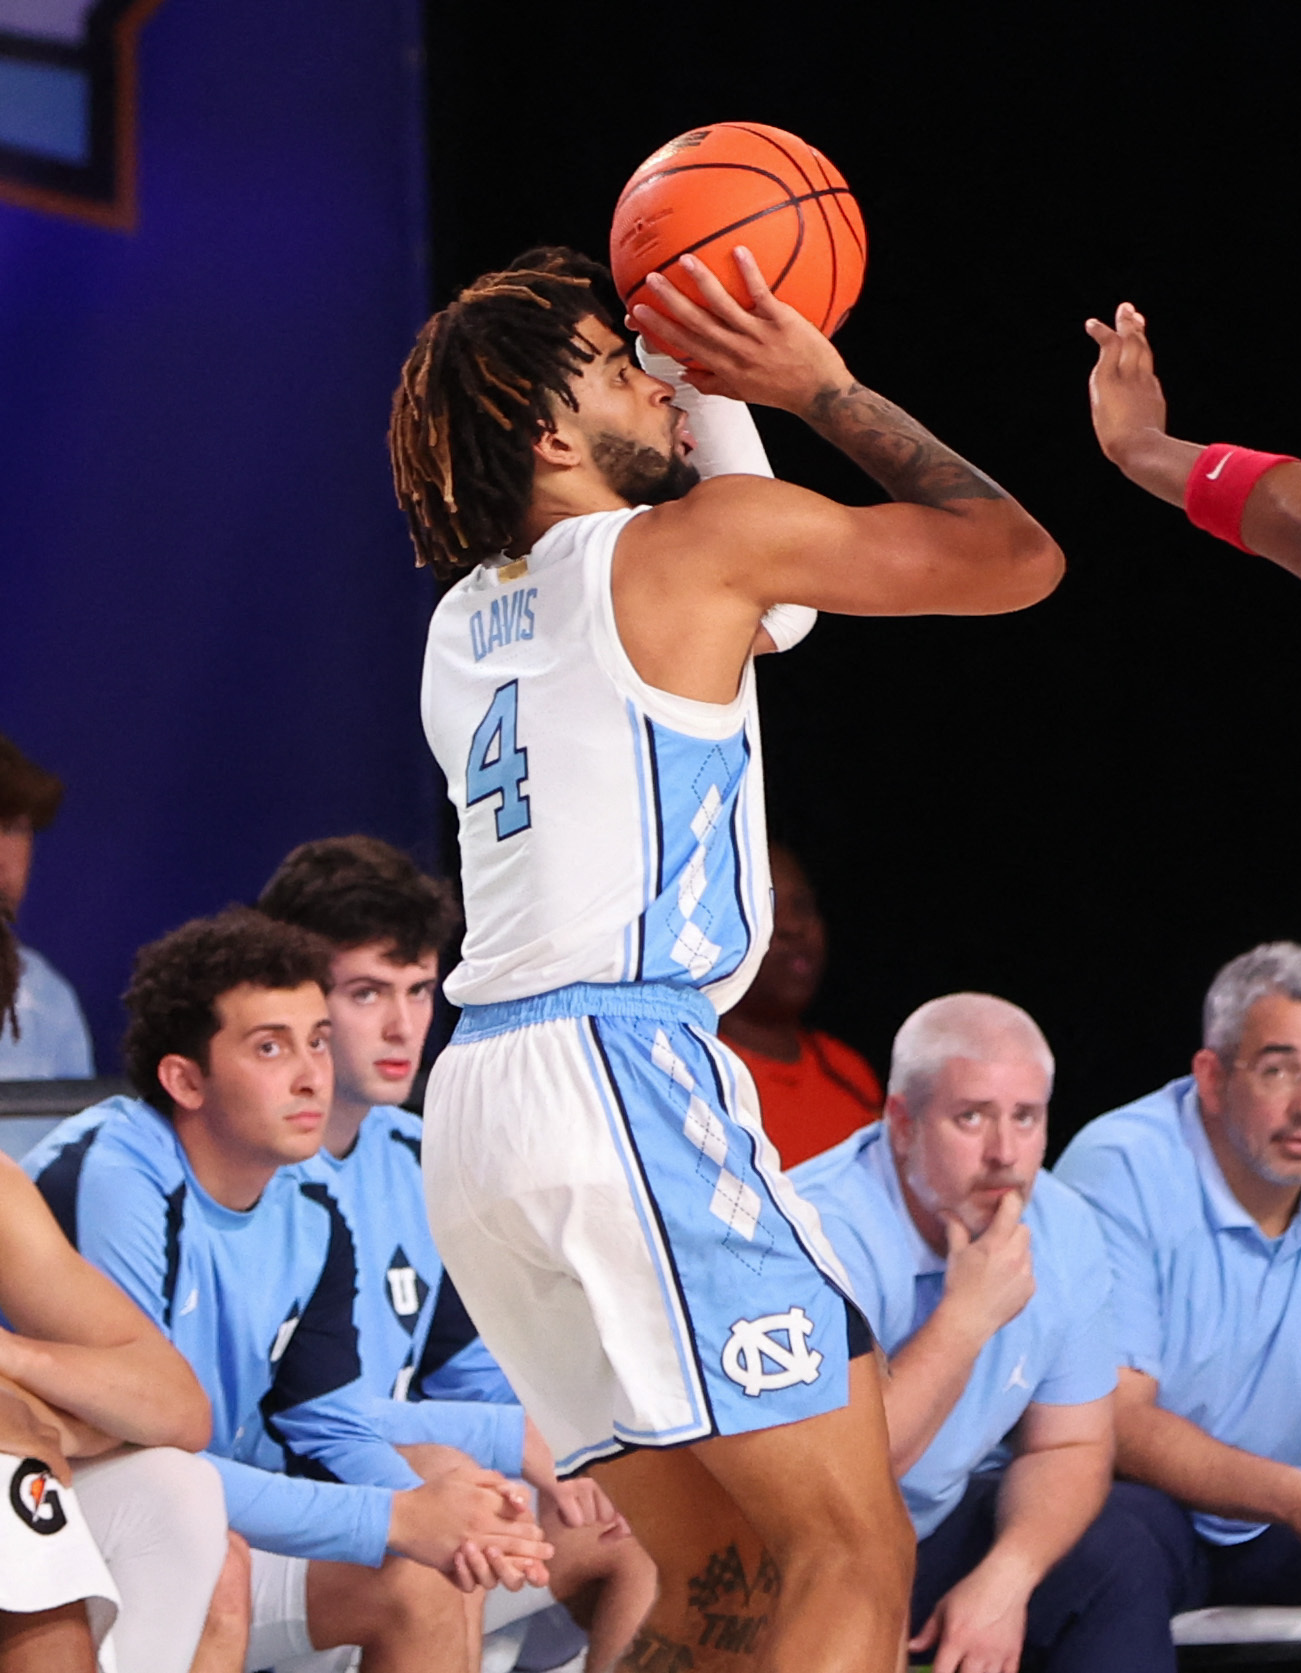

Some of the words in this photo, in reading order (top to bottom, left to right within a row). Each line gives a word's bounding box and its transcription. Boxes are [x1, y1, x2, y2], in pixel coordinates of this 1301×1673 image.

[469, 587, 538, 664] DAVIS
[465, 678, 532, 842] 4
[9, 1457, 68, 1535] G
